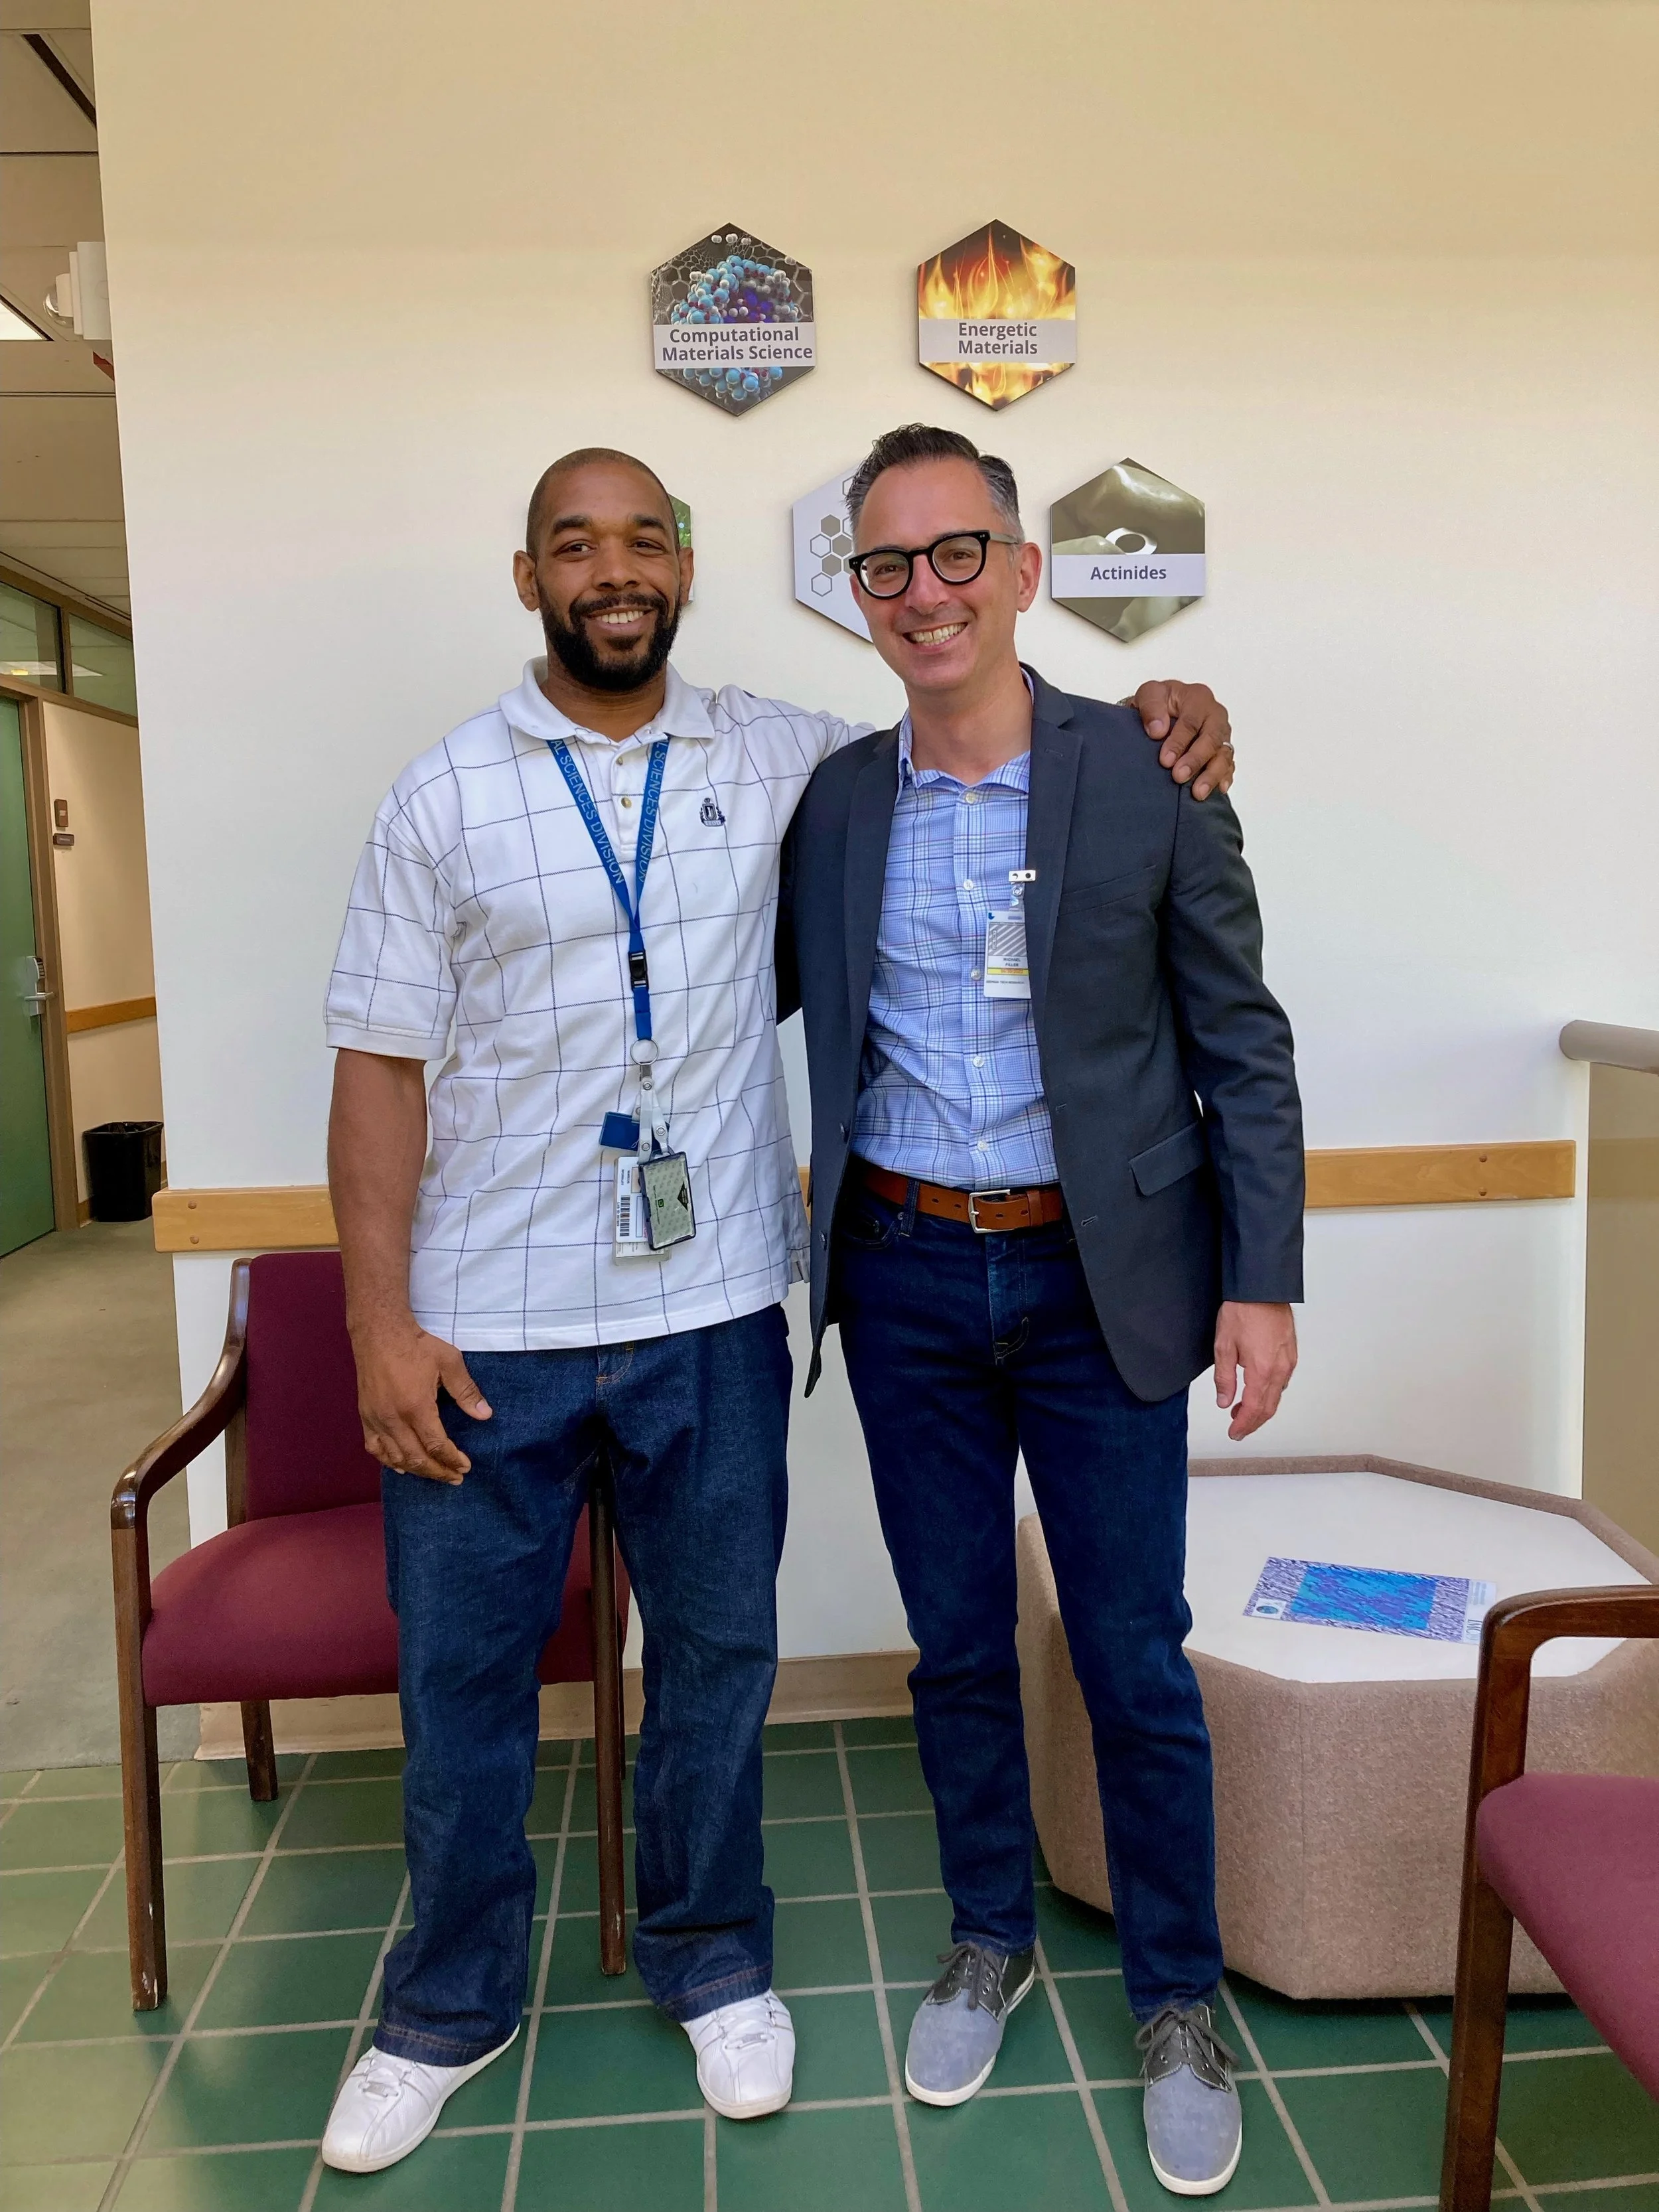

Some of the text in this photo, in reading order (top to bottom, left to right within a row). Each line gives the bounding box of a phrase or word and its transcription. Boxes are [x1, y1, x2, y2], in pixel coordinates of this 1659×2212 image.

[670, 327, 799, 345] Computational
[959, 323, 1037, 340] Energetic
[662, 344, 813, 361] Materials Science
[958, 339, 1038, 354] Materials
[1090, 565, 1167, 580] Actinides
[646, 751, 666, 816] SCIENCES
[559, 755, 598, 820] SCIENCES
[591, 822, 624, 884] DIVISION
[638, 818, 656, 883] DIVISION
